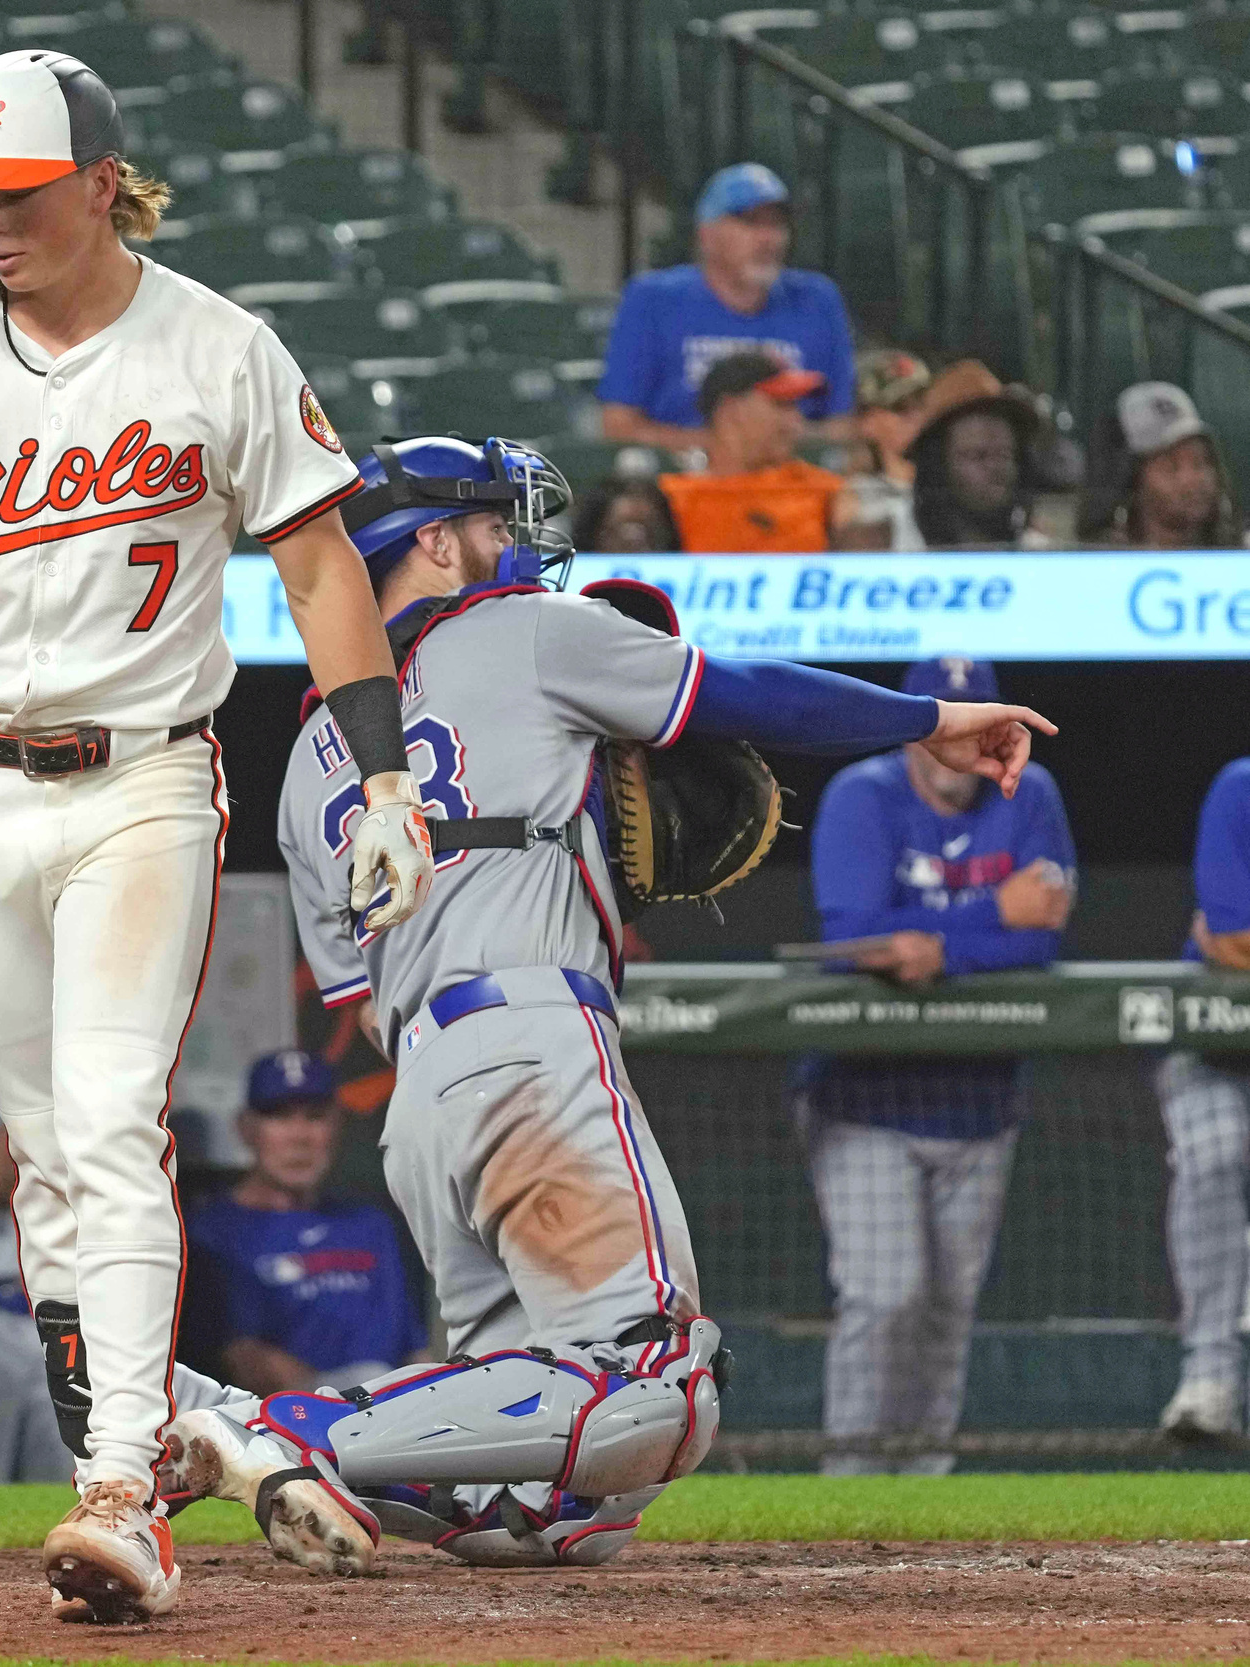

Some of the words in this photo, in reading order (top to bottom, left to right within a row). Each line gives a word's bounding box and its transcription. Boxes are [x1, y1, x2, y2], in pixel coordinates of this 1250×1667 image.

[126, 540, 179, 633] 7
[790, 568, 1014, 612] Breeze
[694, 623, 803, 647] Credit
[87, 742, 98, 765] 7
[60, 1333, 78, 1369] 7
[292, 1405, 306, 1420] 28
